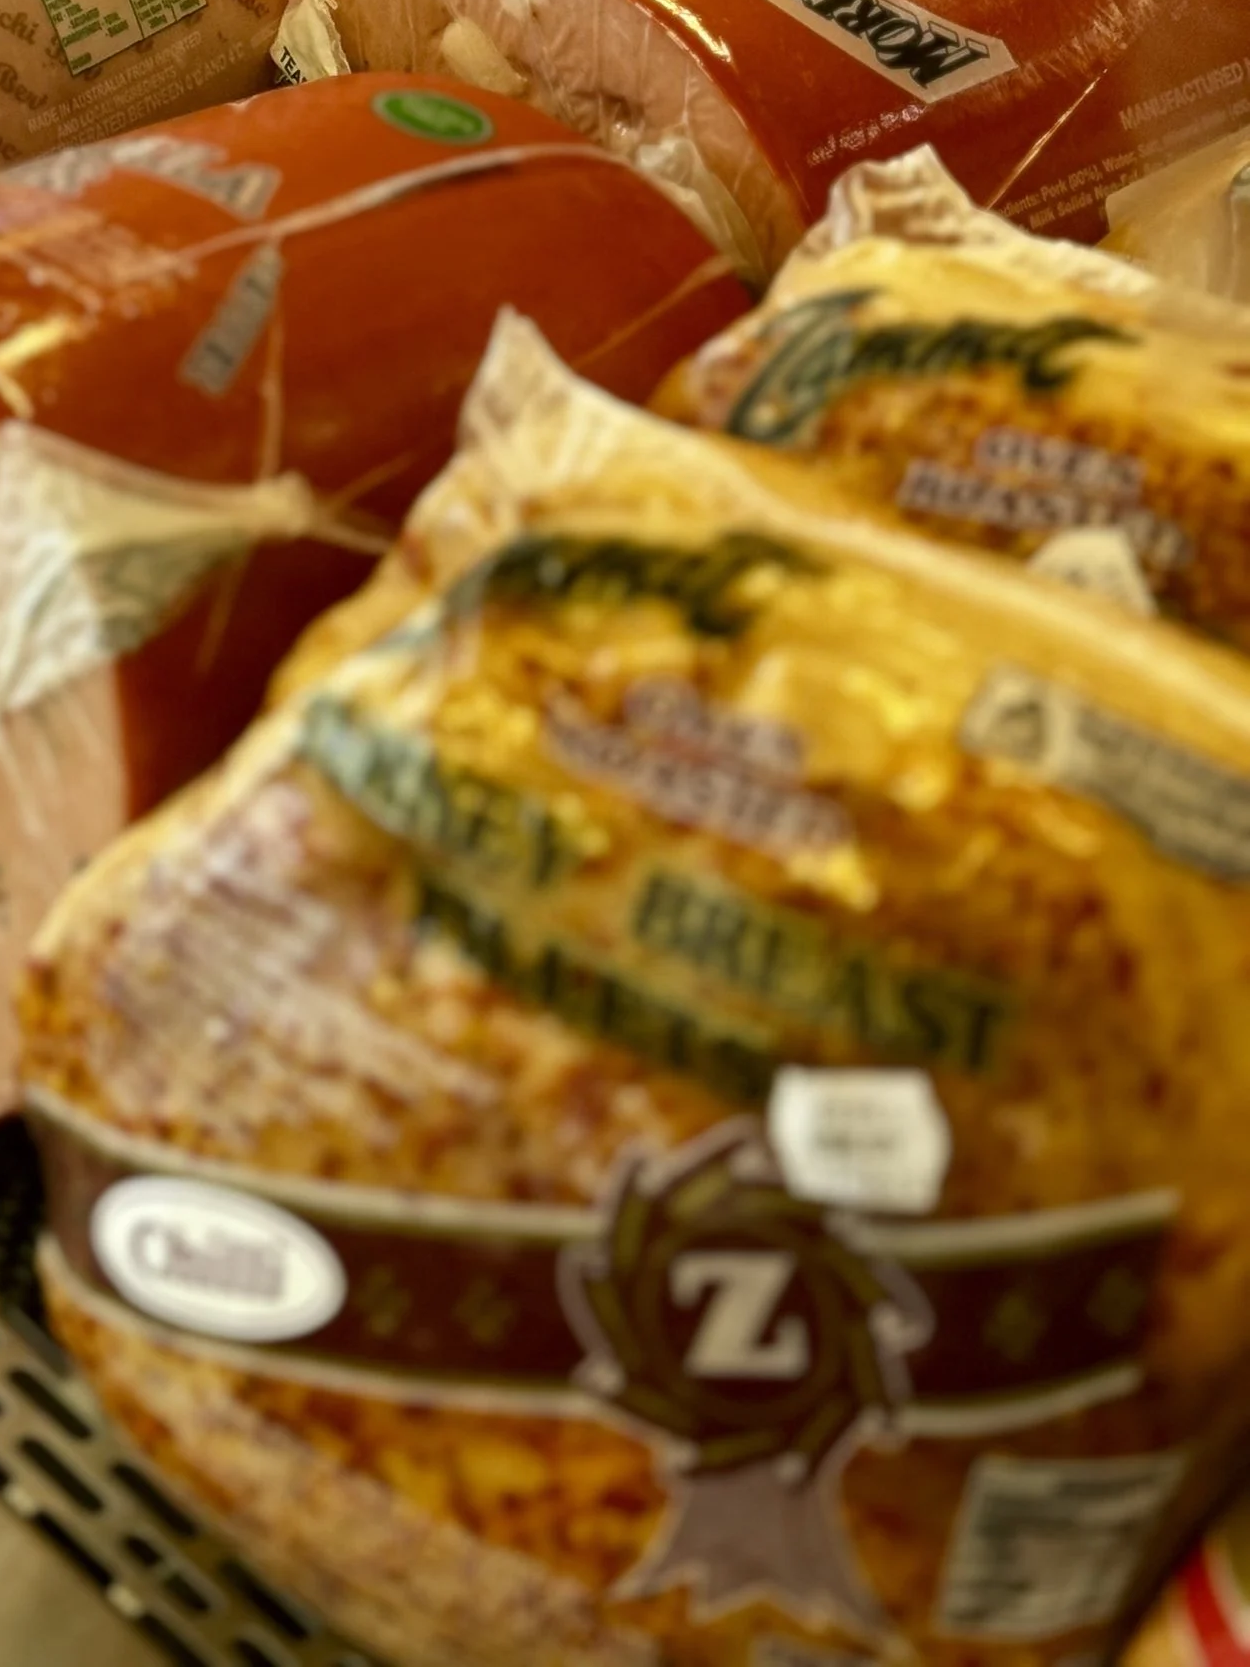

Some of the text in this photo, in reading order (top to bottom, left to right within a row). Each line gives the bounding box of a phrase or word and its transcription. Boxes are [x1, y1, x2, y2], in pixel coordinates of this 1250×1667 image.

[25, 107, 61, 134] MADE
[56, 101, 72, 118] IN
[67, 72, 131, 111] AUSTRALIA
[123, 57, 157, 82] FROM
[123, 53, 231, 123] BETWEEN AND
[279, 45, 309, 85] TEA
[1117, 60, 1248, 132] MANUFACTURED
[1027, 206, 1057, 230] Milk
[1054, 190, 1095, 219] Solids
[1038, 177, 1069, 203] Pork
[669, 1252, 806, 1380] Z
